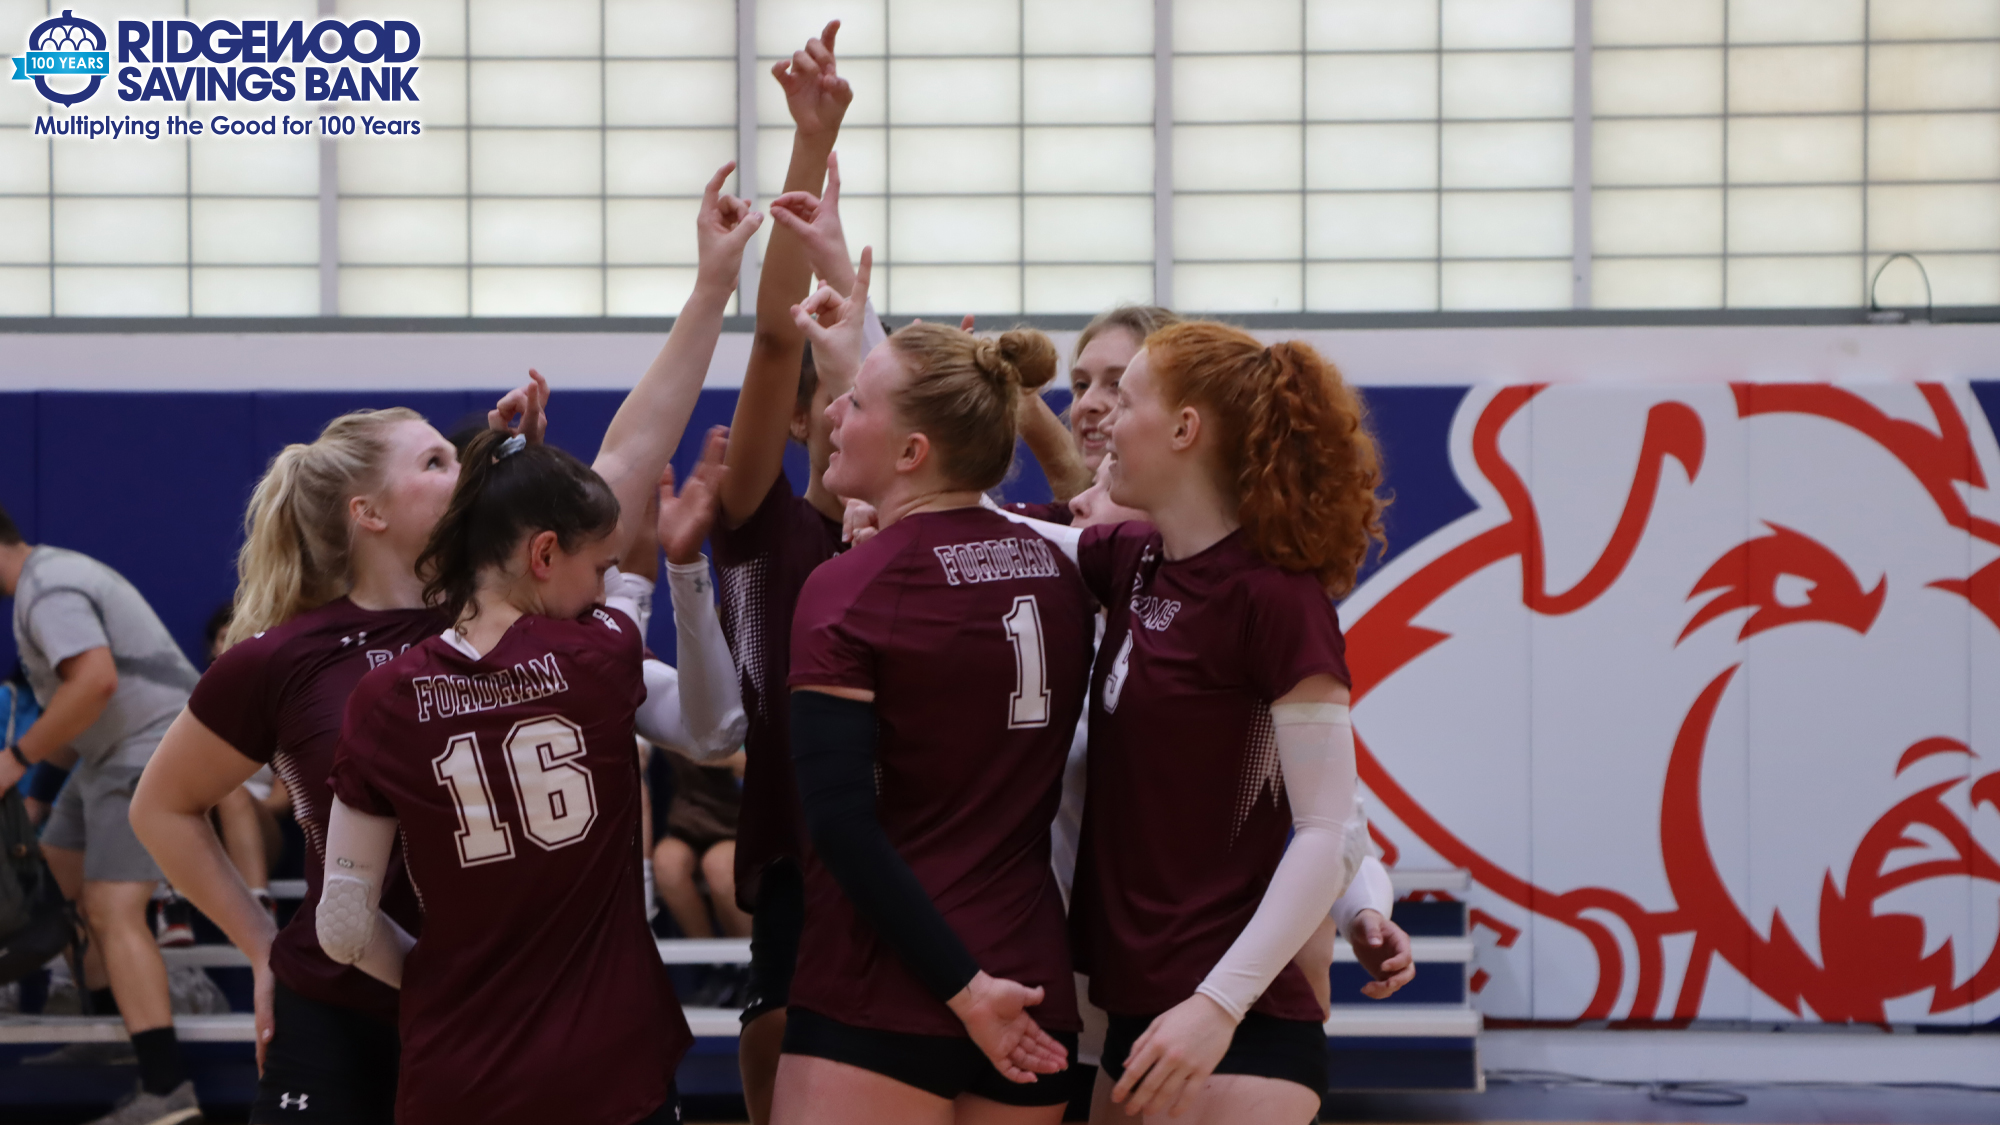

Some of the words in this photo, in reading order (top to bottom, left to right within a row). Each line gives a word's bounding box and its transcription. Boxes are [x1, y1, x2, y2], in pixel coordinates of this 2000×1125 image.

[934, 537, 1060, 586] FORDHAM
[413, 652, 569, 722] FORDHAM
[1002, 595, 1051, 729] 1
[431, 713, 598, 868] 16
